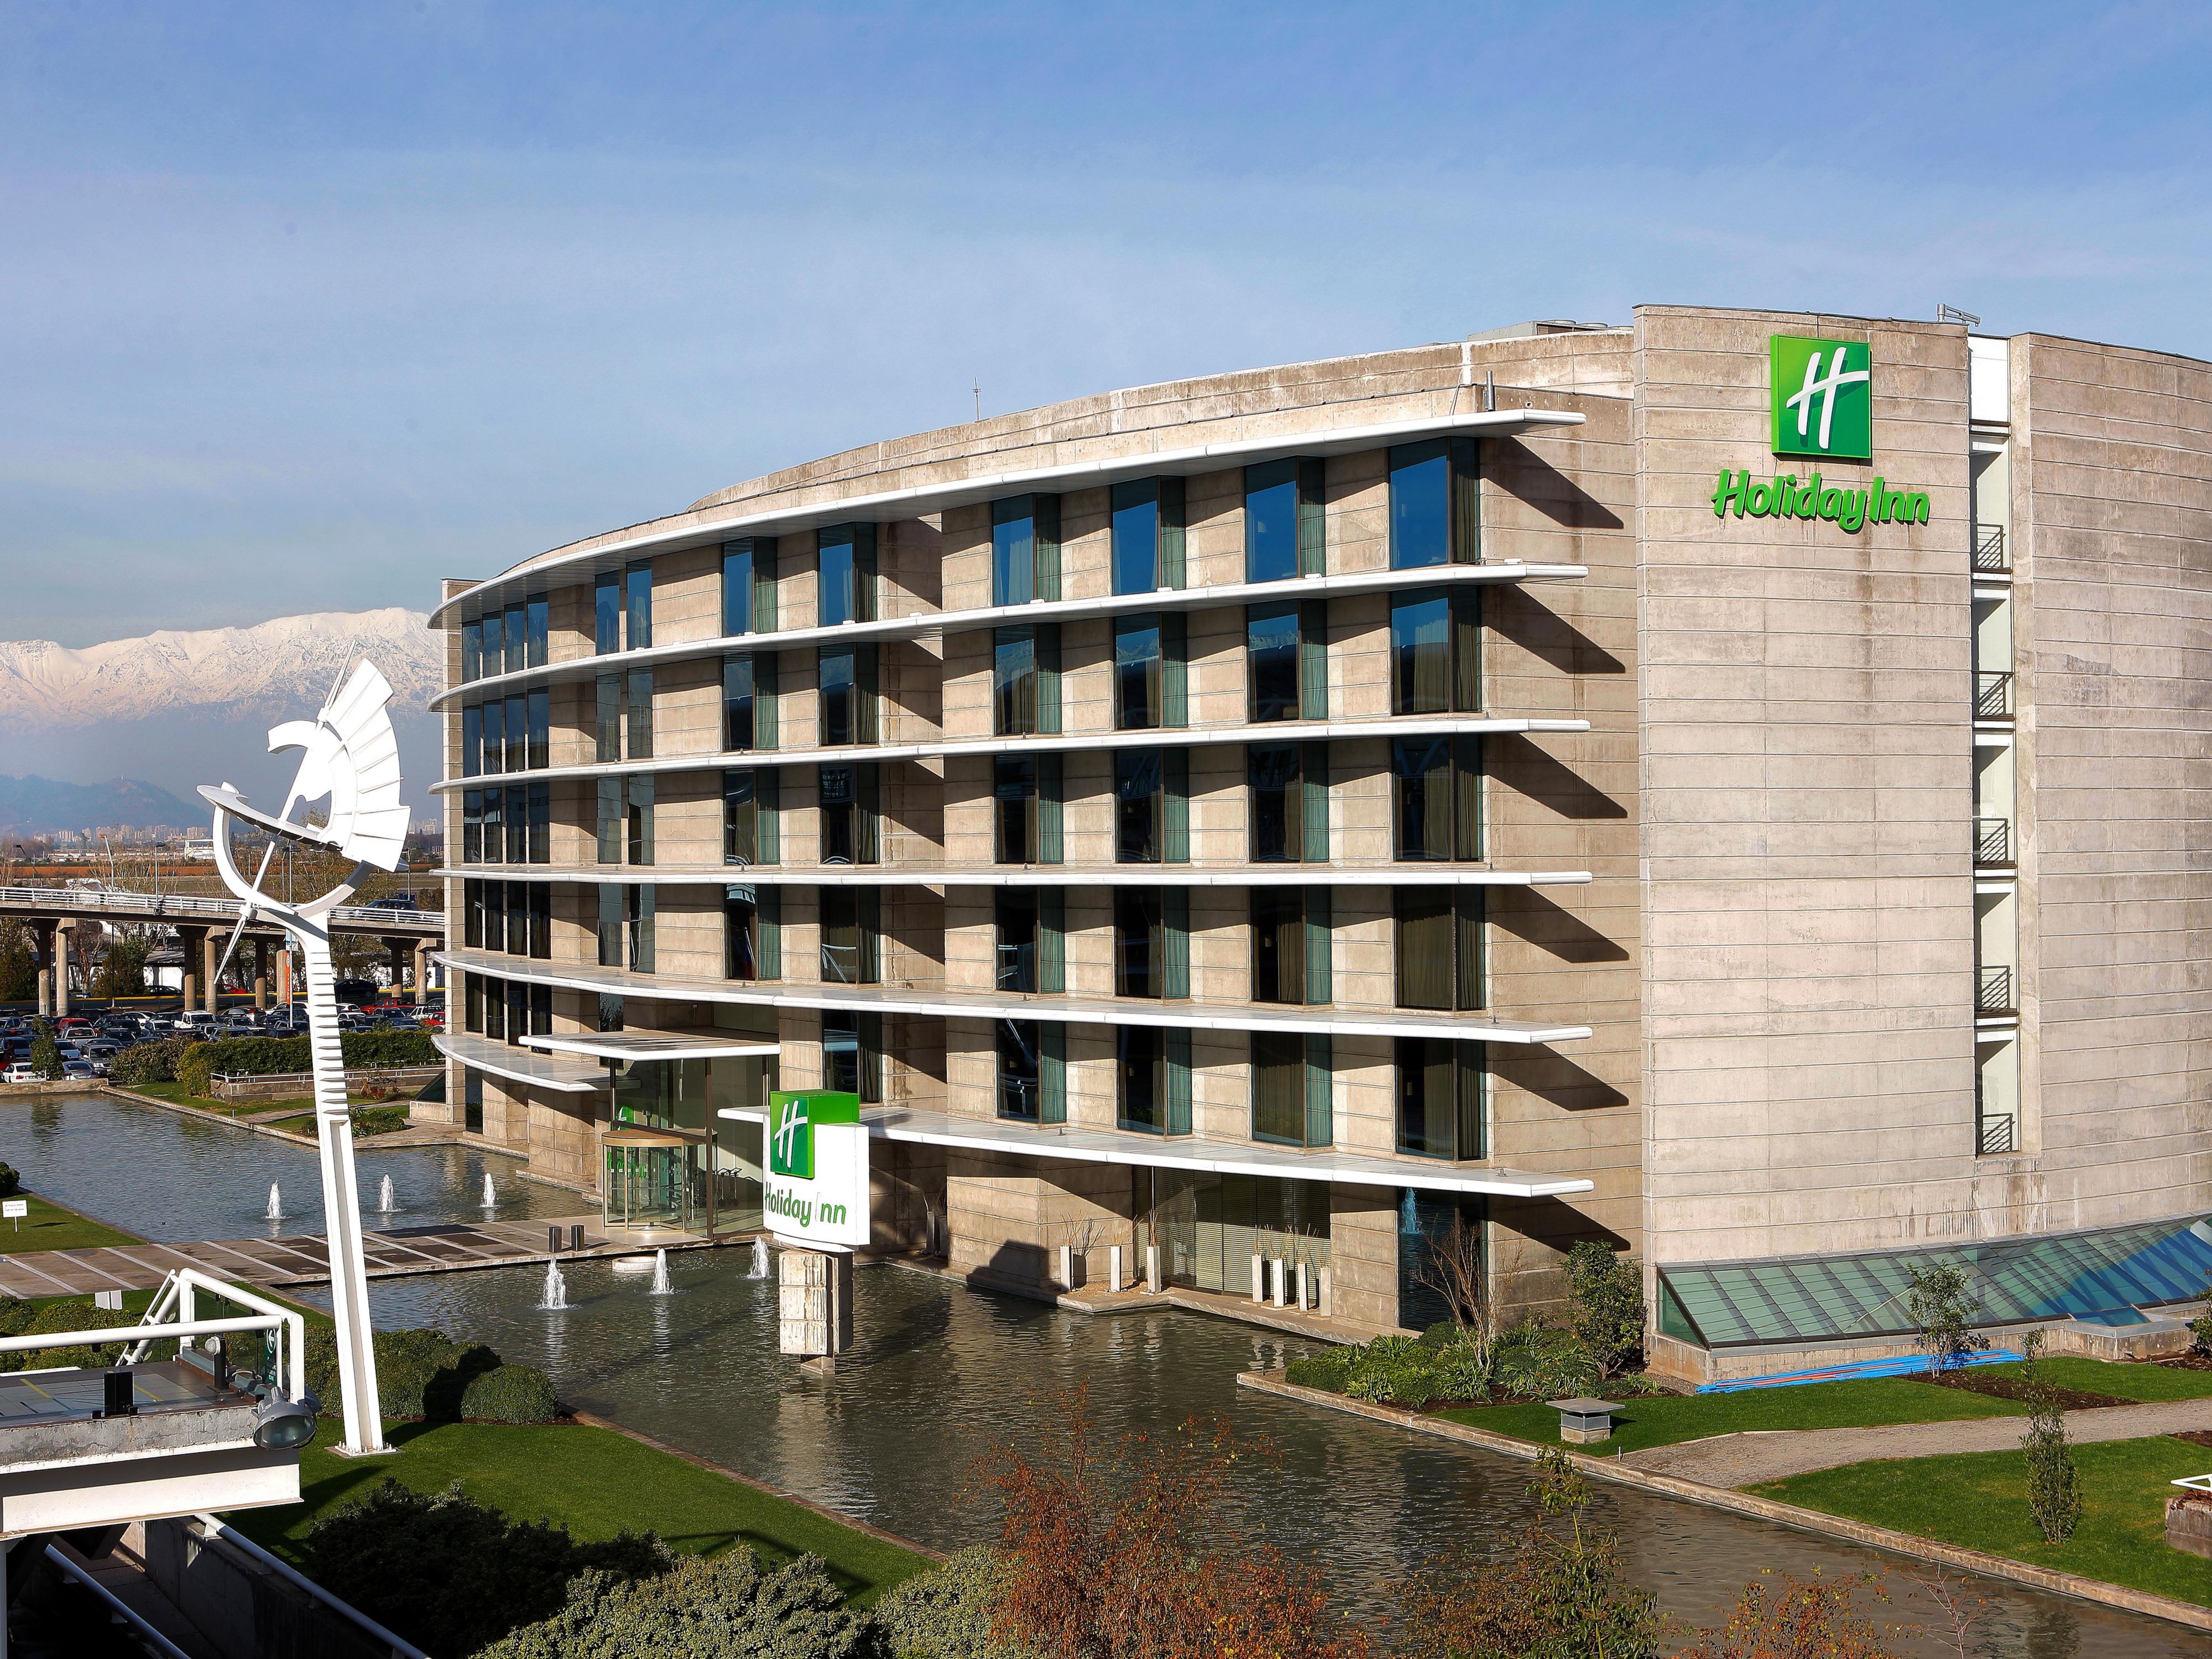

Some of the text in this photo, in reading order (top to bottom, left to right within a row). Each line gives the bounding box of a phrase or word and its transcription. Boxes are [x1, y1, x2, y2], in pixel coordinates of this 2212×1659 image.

[1711, 469, 1930, 531] Holiday Inn
[765, 1181, 812, 1228] Holiday
